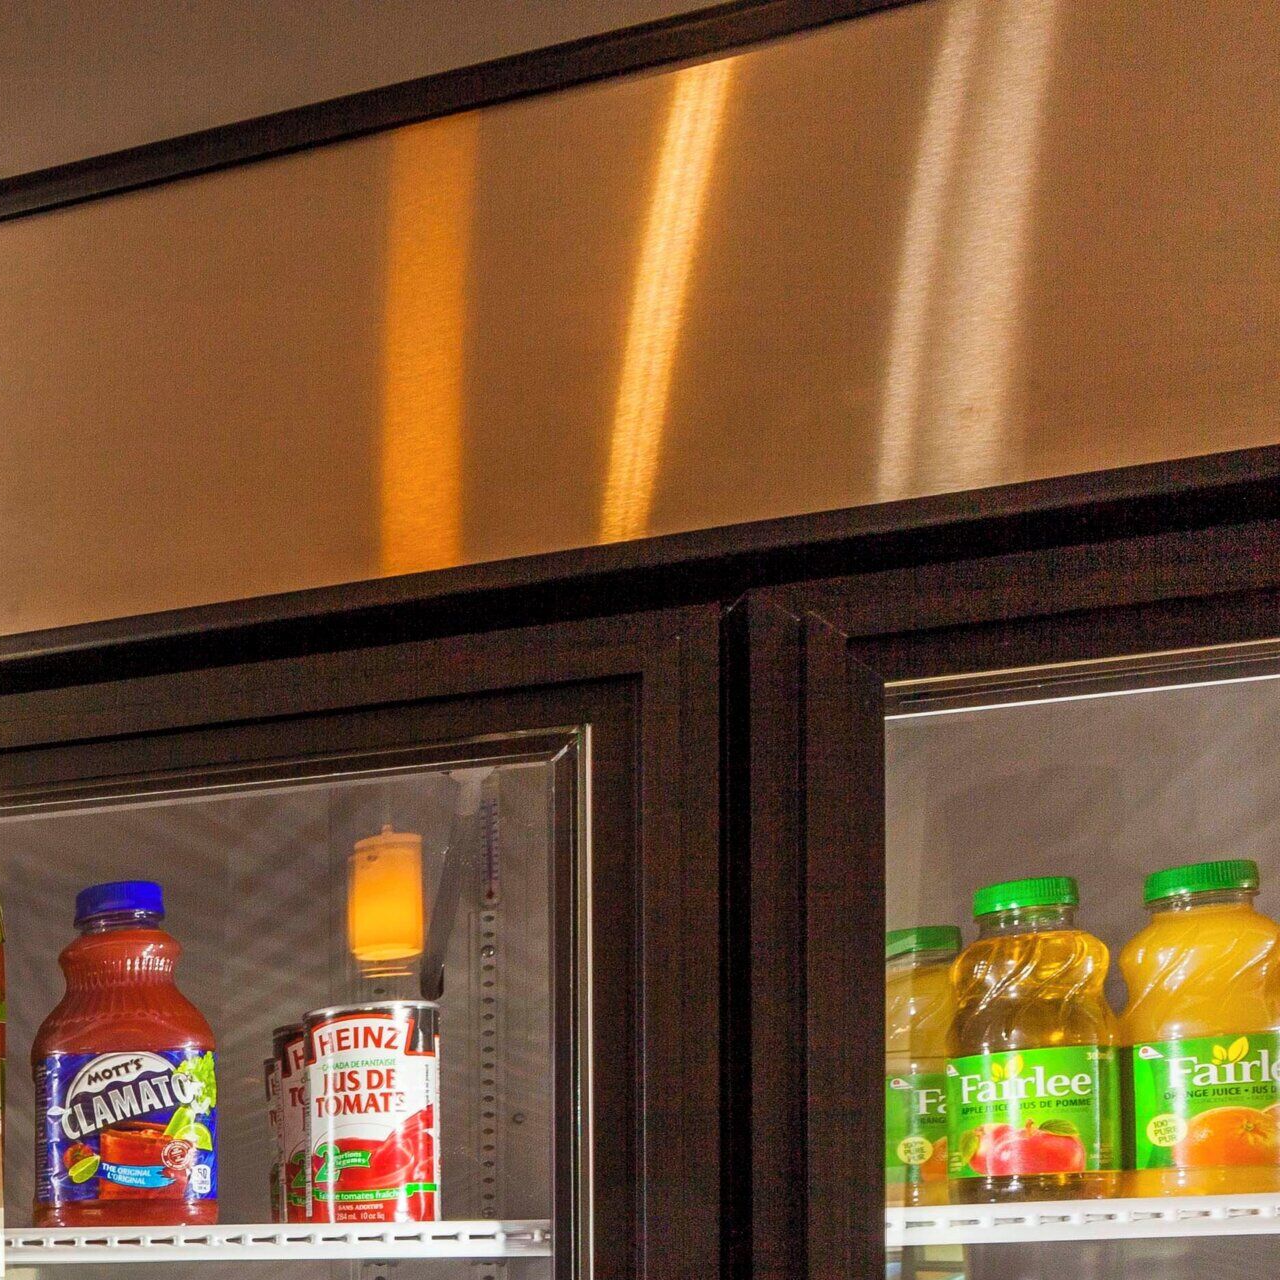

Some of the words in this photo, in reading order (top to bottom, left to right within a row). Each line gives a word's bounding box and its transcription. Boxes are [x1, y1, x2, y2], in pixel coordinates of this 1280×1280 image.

[319, 1026, 400, 1056] HEINZ
[87, 1058, 143, 1086] MOTT'S
[324, 1069, 363, 1095] JUS
[366, 1069, 395, 1089] DE
[960, 1065, 1092, 1105] Fairlee
[1212, 1087, 1242, 1096] JUICE
[1252, 1085, 1268, 1093] JUS
[62, 1073, 192, 1140] CLAMATO
[962, 1106, 982, 1115] APPLE
[1040, 1101, 1052, 1109] DE
[1056, 1098, 1091, 1107] POMME
[102, 1163, 116, 1172] THE
[117, 1166, 151, 1177] ORIGINAL
[315, 1144, 340, 1182] 2
[107, 1172, 146, 1185] L'ORIGINAL
